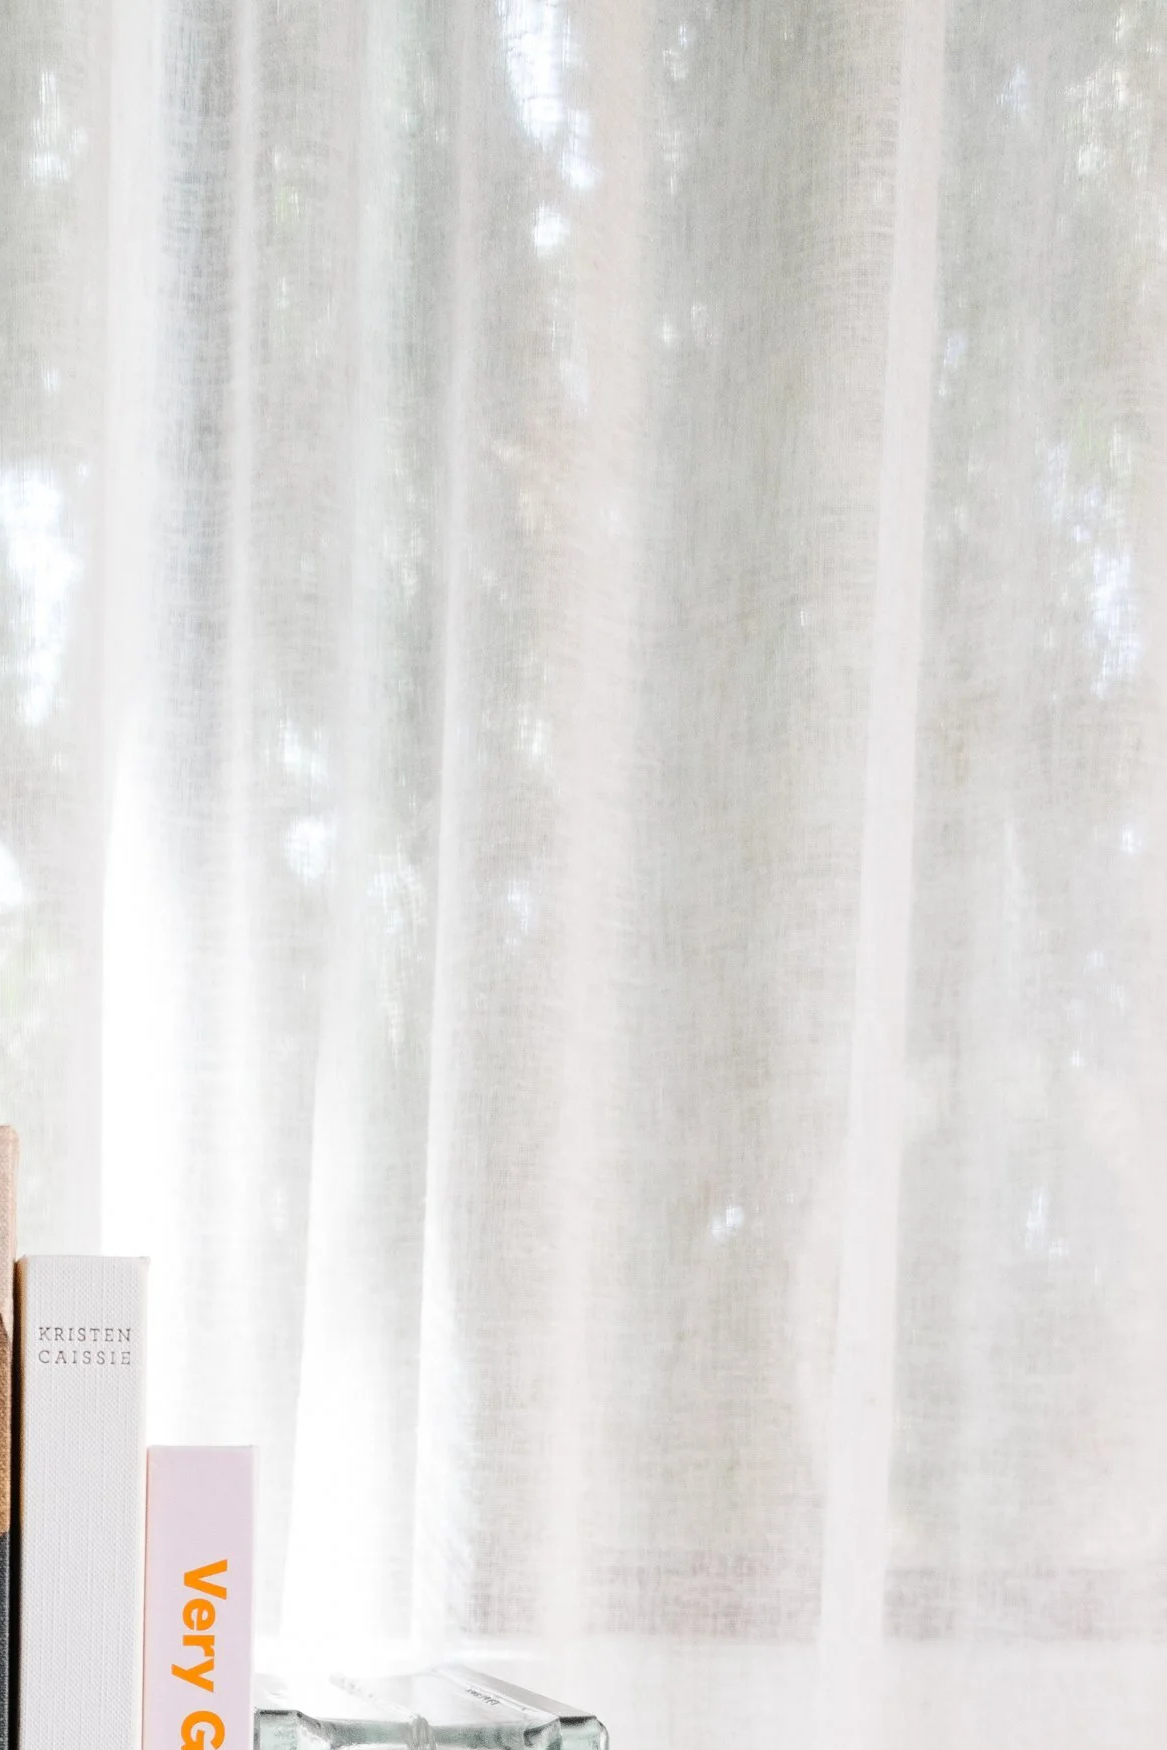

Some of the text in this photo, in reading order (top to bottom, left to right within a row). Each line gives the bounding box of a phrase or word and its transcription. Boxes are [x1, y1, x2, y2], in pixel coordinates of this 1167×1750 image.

[38, 1327, 131, 1342] KRISTEN
[38, 1350, 131, 1365] CAISSIE
[171, 1558, 230, 1693] Very
